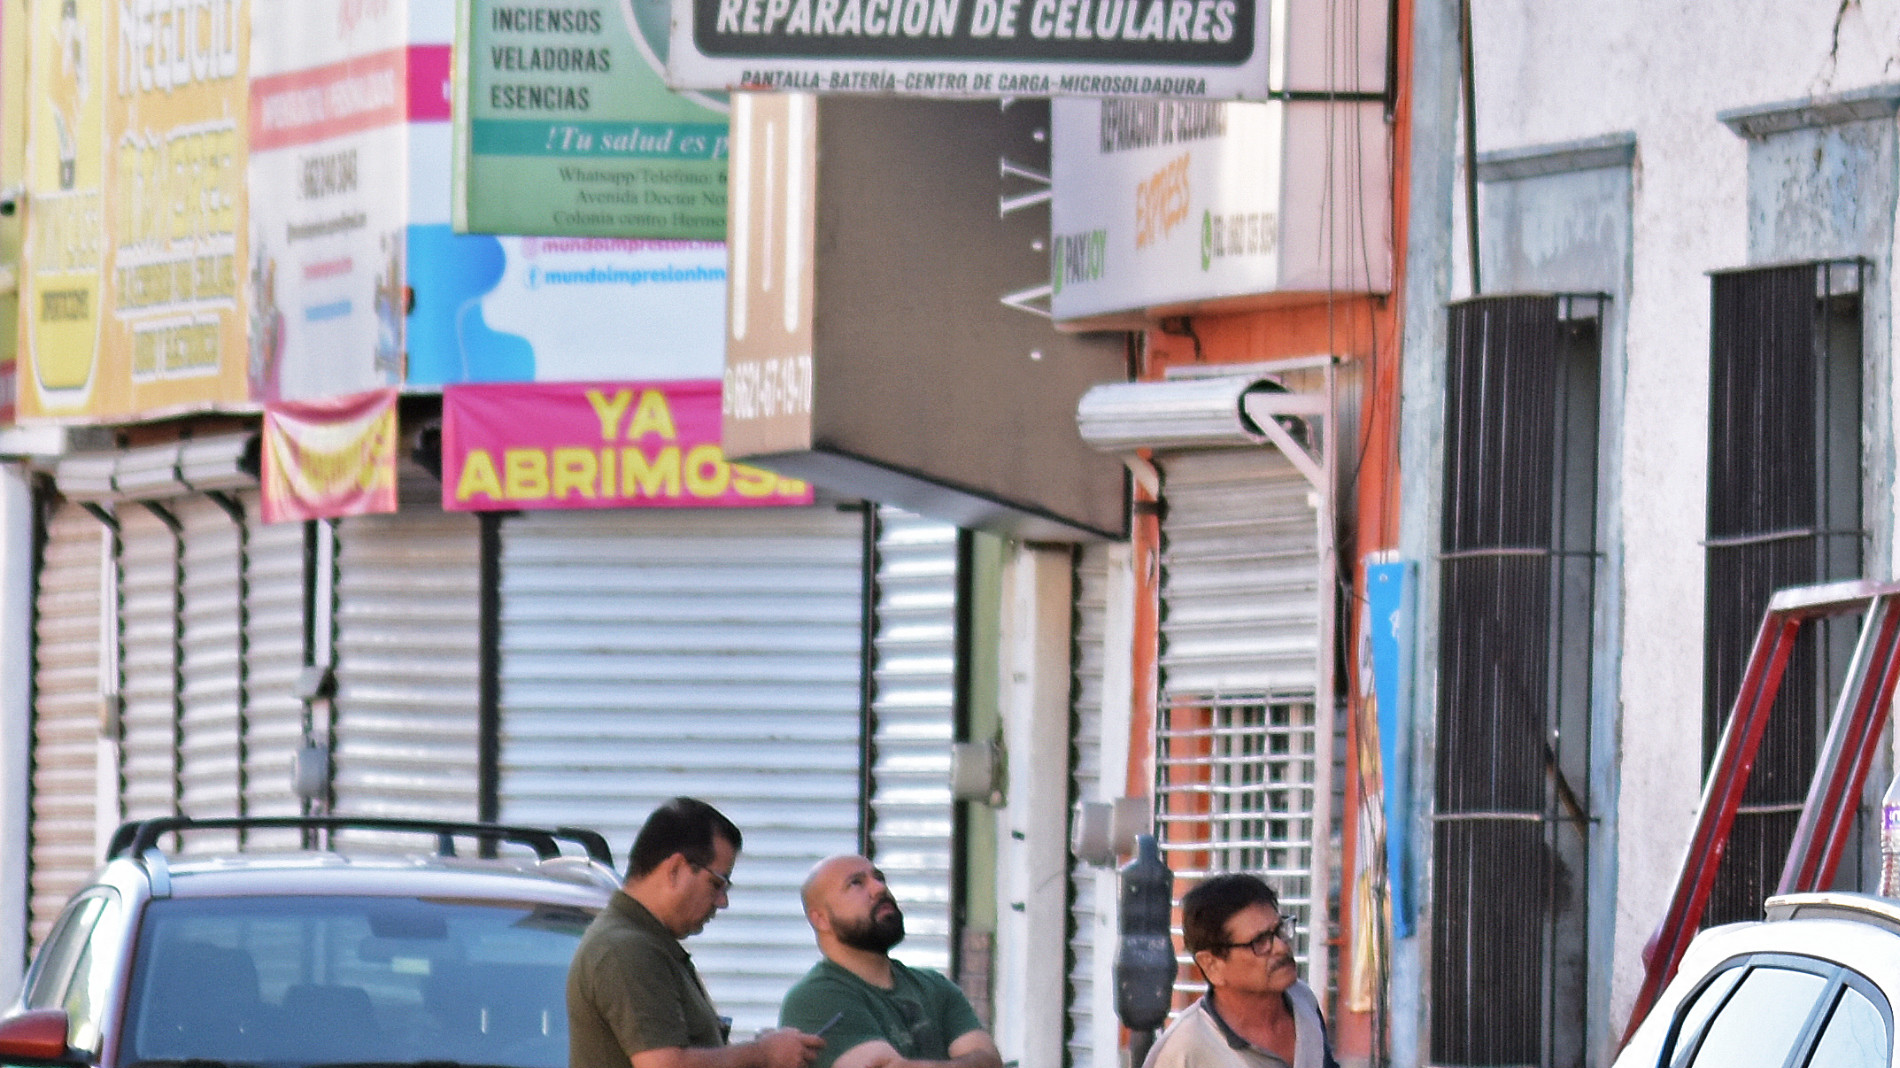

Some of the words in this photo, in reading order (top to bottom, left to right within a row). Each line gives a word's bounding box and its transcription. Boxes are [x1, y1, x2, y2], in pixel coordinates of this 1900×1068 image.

[491, 7, 602, 33] INCIENSOS
[970, 0, 1021, 37] DE
[1030, 0, 1237, 43] CELULARES
[491, 47, 611, 72] VELADORAS
[490, 84, 590, 110] ESENCIAS
[600, 127, 674, 152] salud
[679, 135, 706, 153] es
[585, 388, 677, 441] YA
